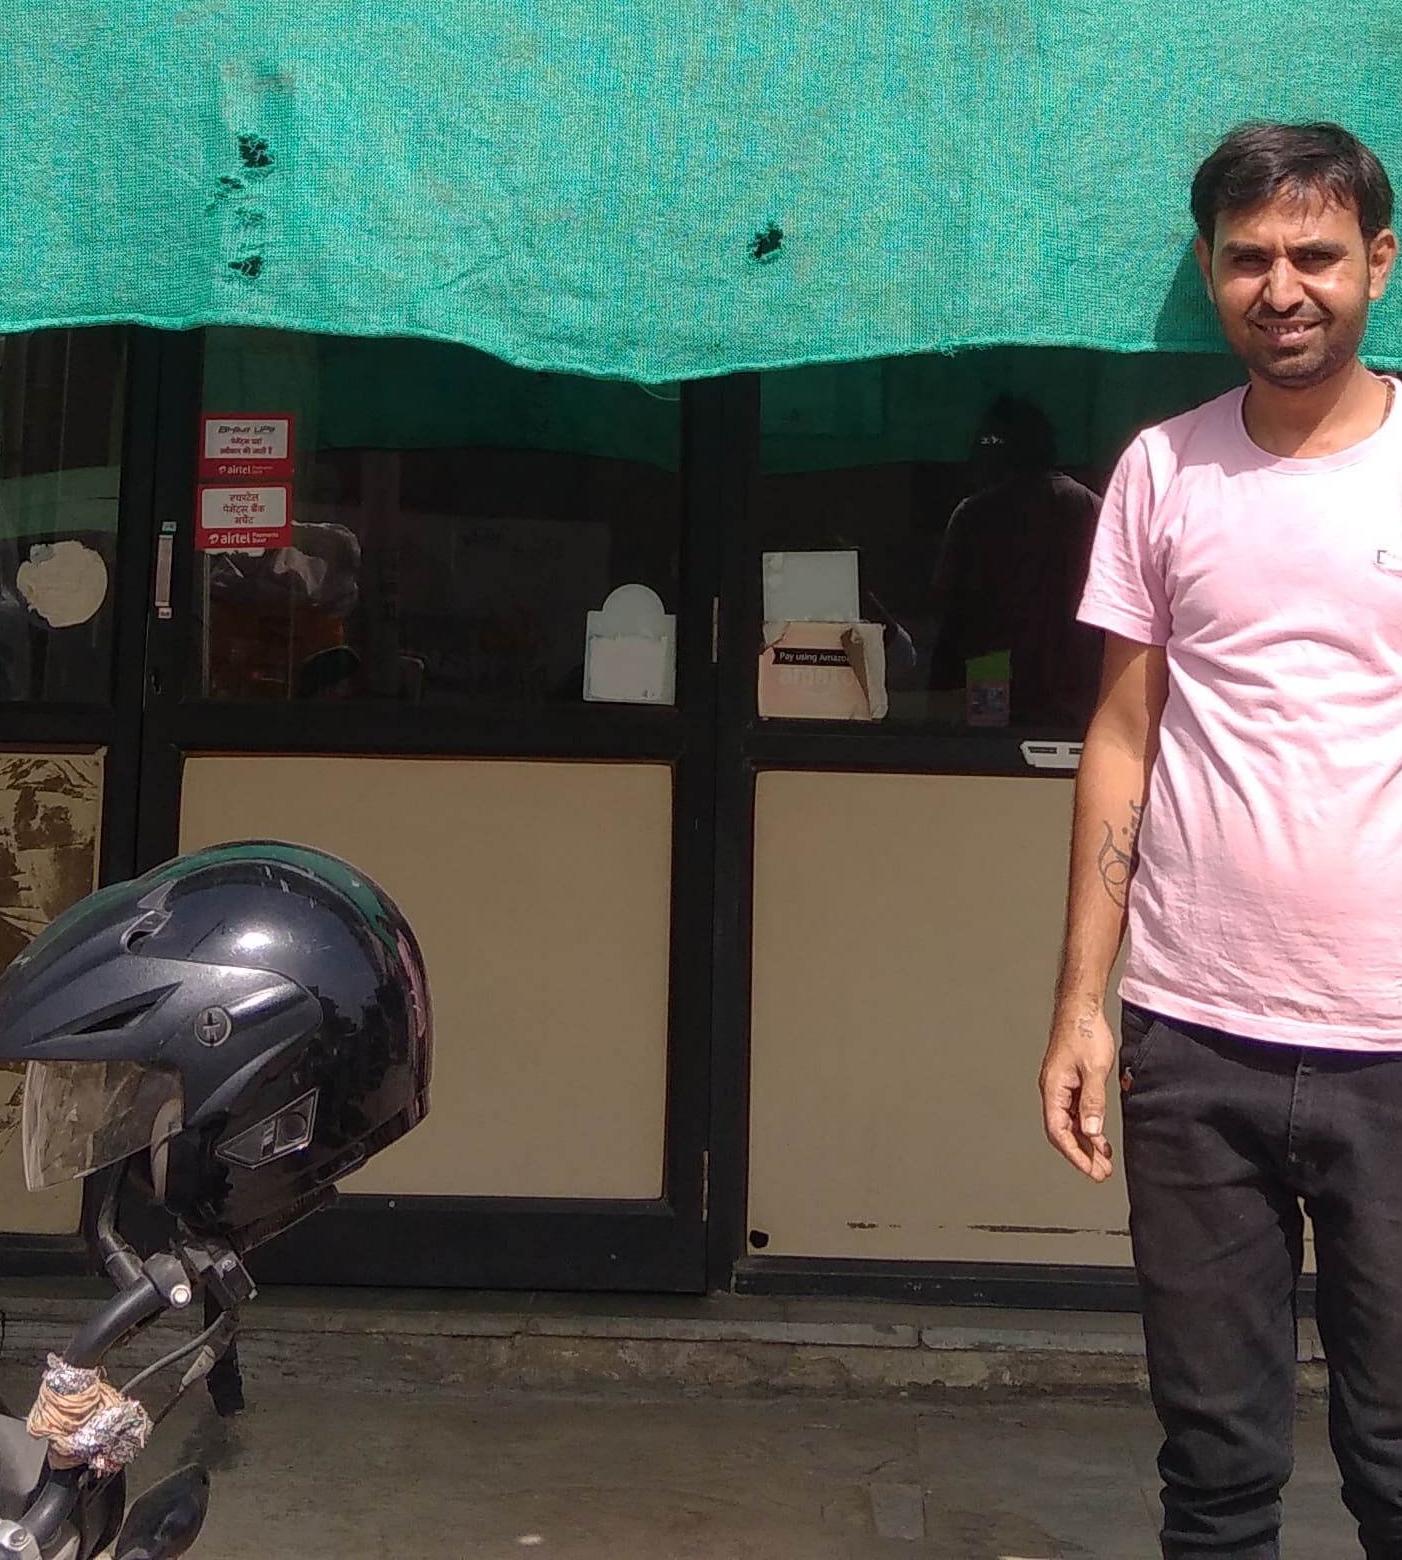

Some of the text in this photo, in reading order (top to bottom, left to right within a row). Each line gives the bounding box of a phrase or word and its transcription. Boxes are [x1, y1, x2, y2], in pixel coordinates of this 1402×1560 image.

[227, 464, 251, 475] airtel
[220, 532, 251, 544] airtel
[779, 651, 850, 663] Pay using Amazo
